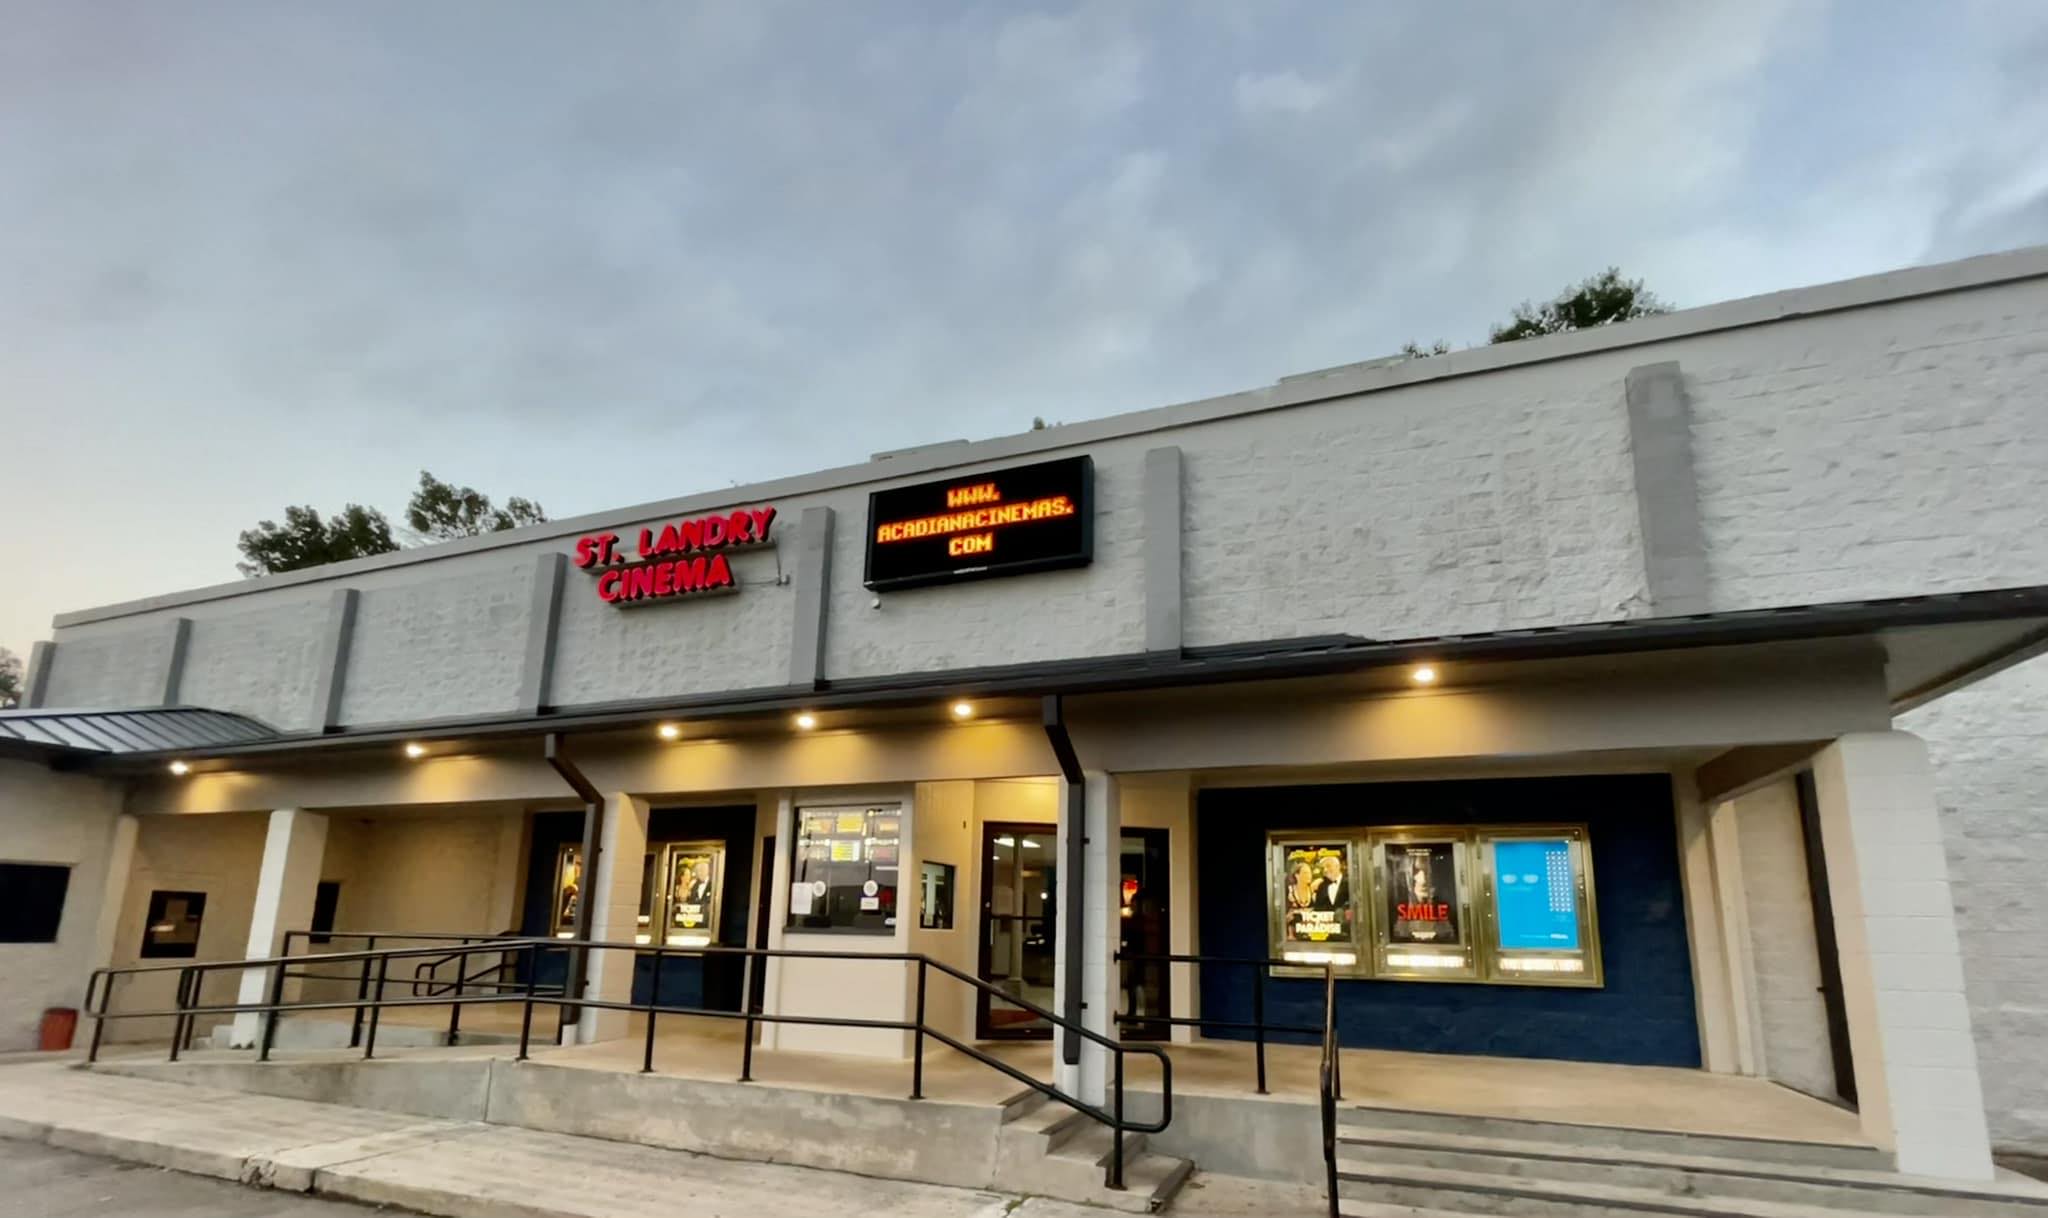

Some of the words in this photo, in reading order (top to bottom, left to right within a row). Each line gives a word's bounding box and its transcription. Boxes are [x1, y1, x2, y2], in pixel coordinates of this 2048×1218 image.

[574, 531, 625, 568] ST.
[639, 504, 776, 557] LANDRY
[877, 496, 1074, 543] ACADIANACINEMAS.
[949, 533, 993, 556] COM
[598, 553, 735, 603] CINEMA
[1397, 903, 1449, 921] SMILE
